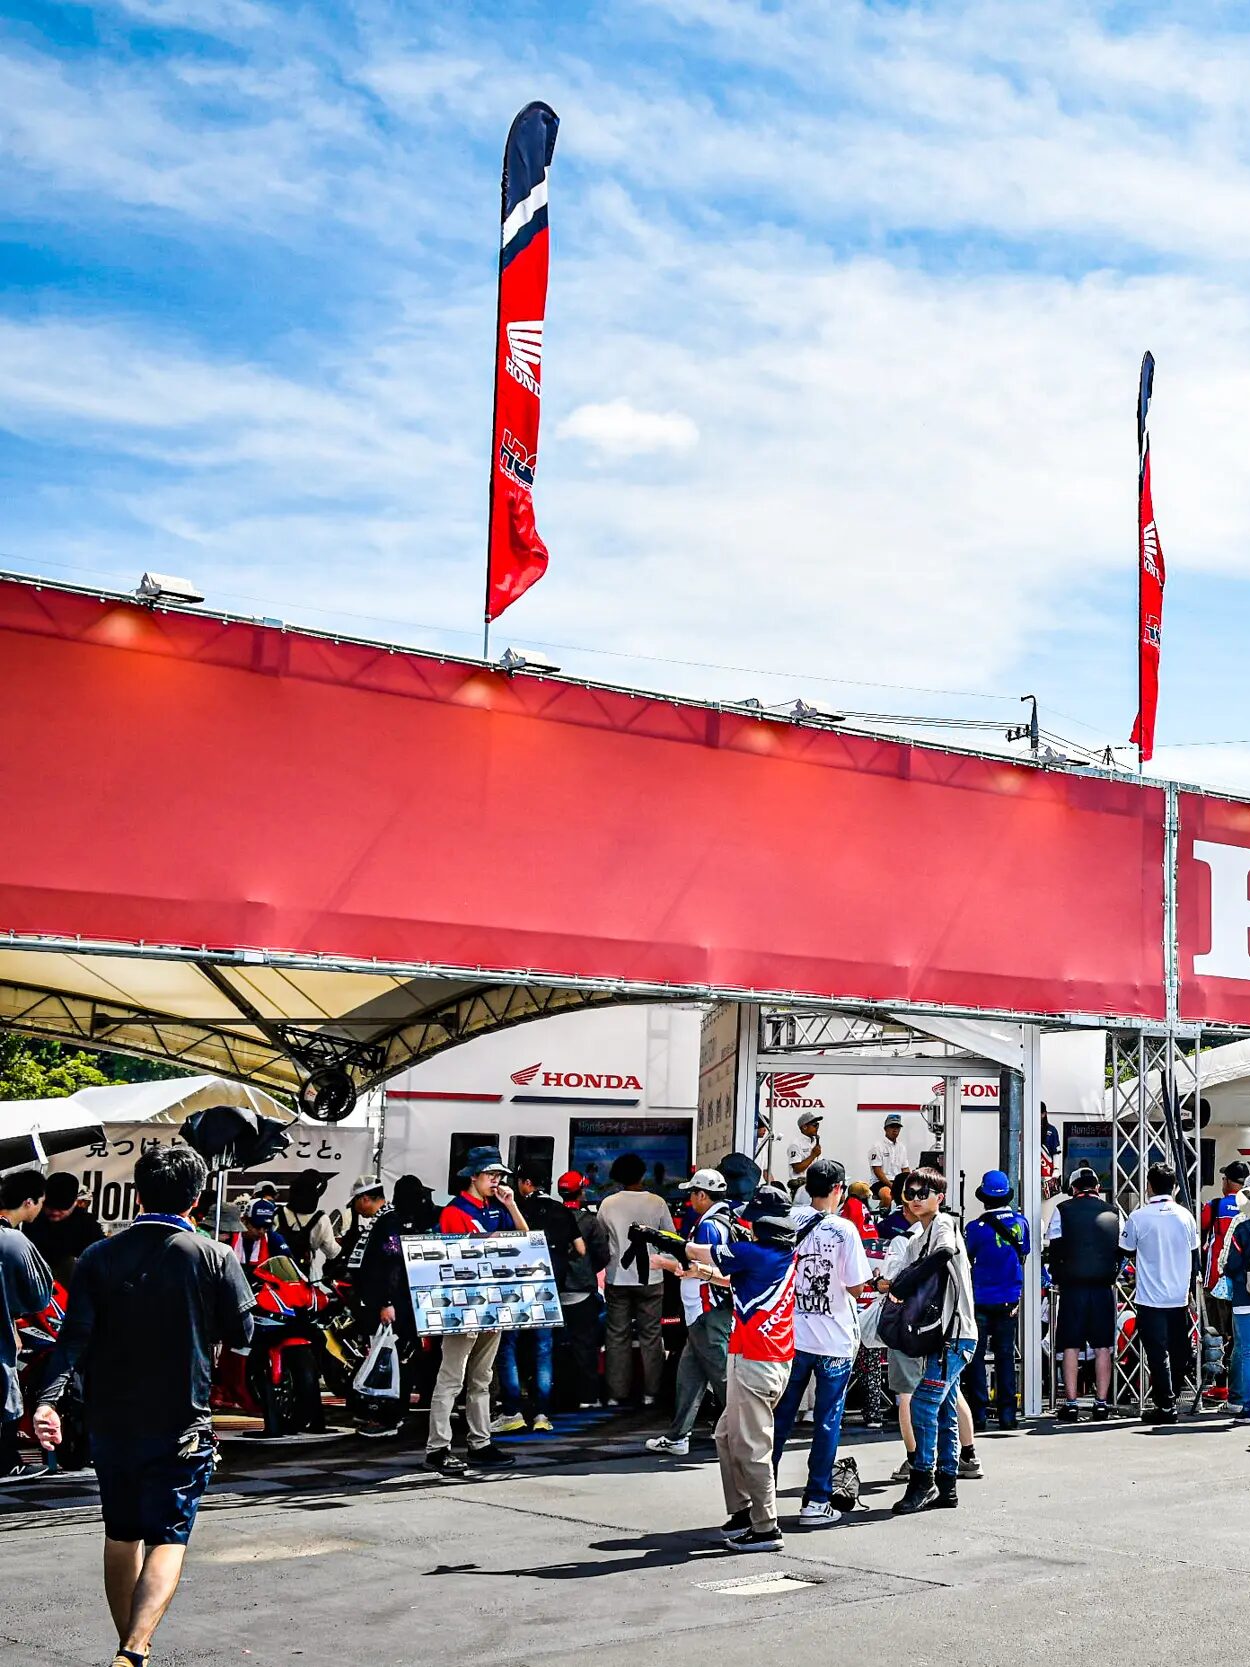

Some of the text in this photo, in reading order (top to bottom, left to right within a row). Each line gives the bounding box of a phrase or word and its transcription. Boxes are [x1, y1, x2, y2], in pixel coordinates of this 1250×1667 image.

[506, 356, 541, 399] HOND
[541, 1072, 643, 1090] HONDA
[961, 1084, 999, 1098] HON
[766, 1098, 825, 1109] HONDA
[83, 1171, 140, 1221] Hon
[758, 1286, 794, 1337] HOND
